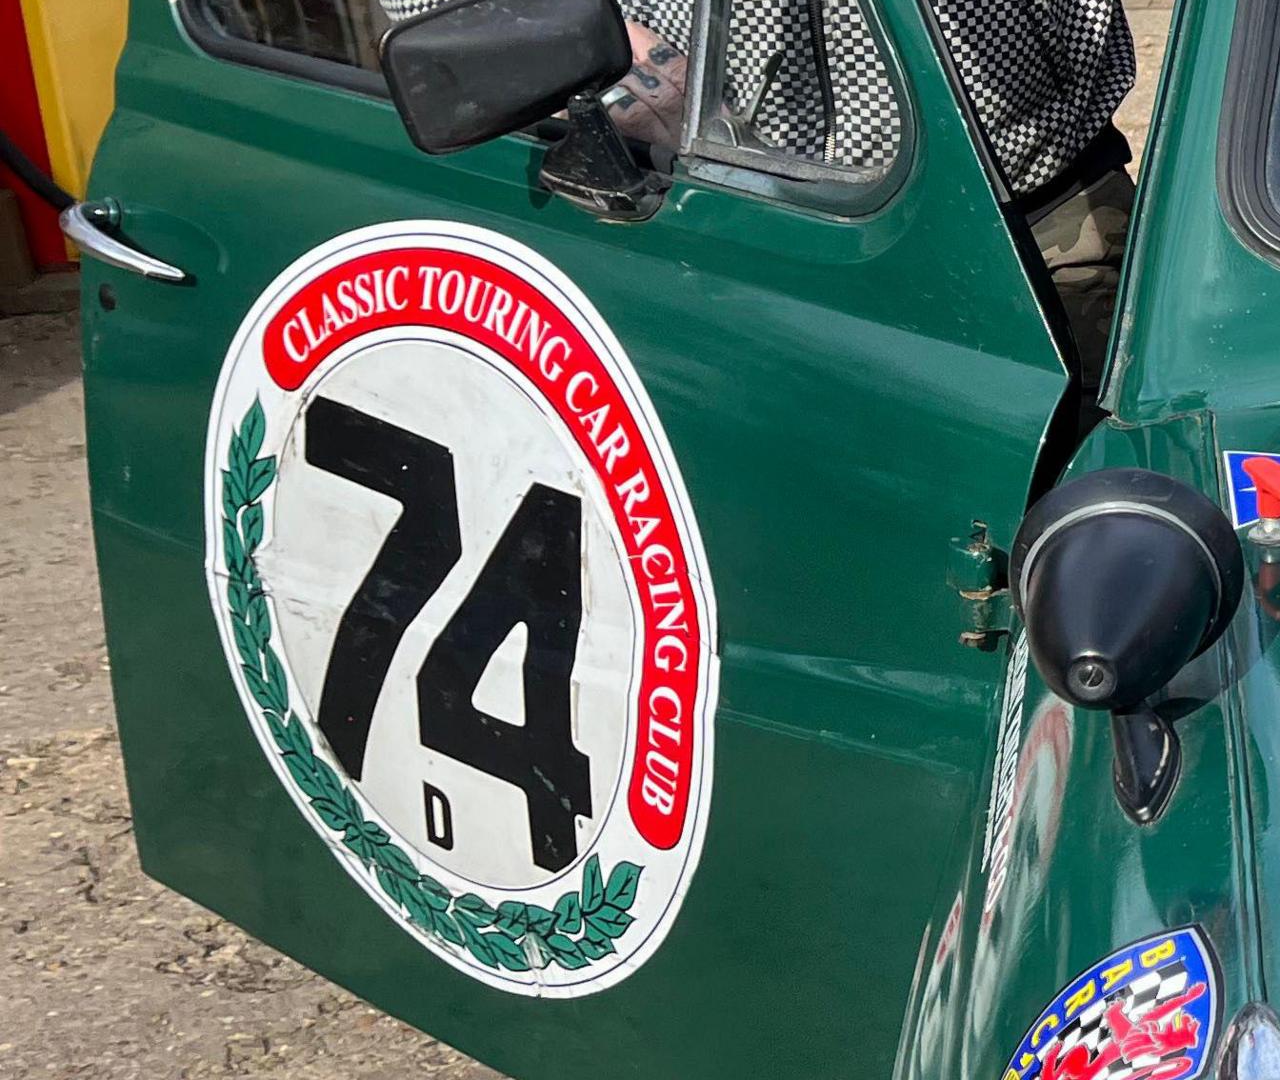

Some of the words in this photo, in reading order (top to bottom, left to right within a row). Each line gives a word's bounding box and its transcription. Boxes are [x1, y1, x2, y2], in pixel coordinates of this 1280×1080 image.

[281, 265, 410, 362] CLASSIC
[418, 266, 572, 382] TOURING
[564, 371, 630, 476] CAR
[614, 469, 688, 674] RACING
[304, 395, 593, 873] 74
[641, 686, 683, 817] CLUB
[422, 780, 454, 851] D
[1031, 939, 1177, 1047] BARC
